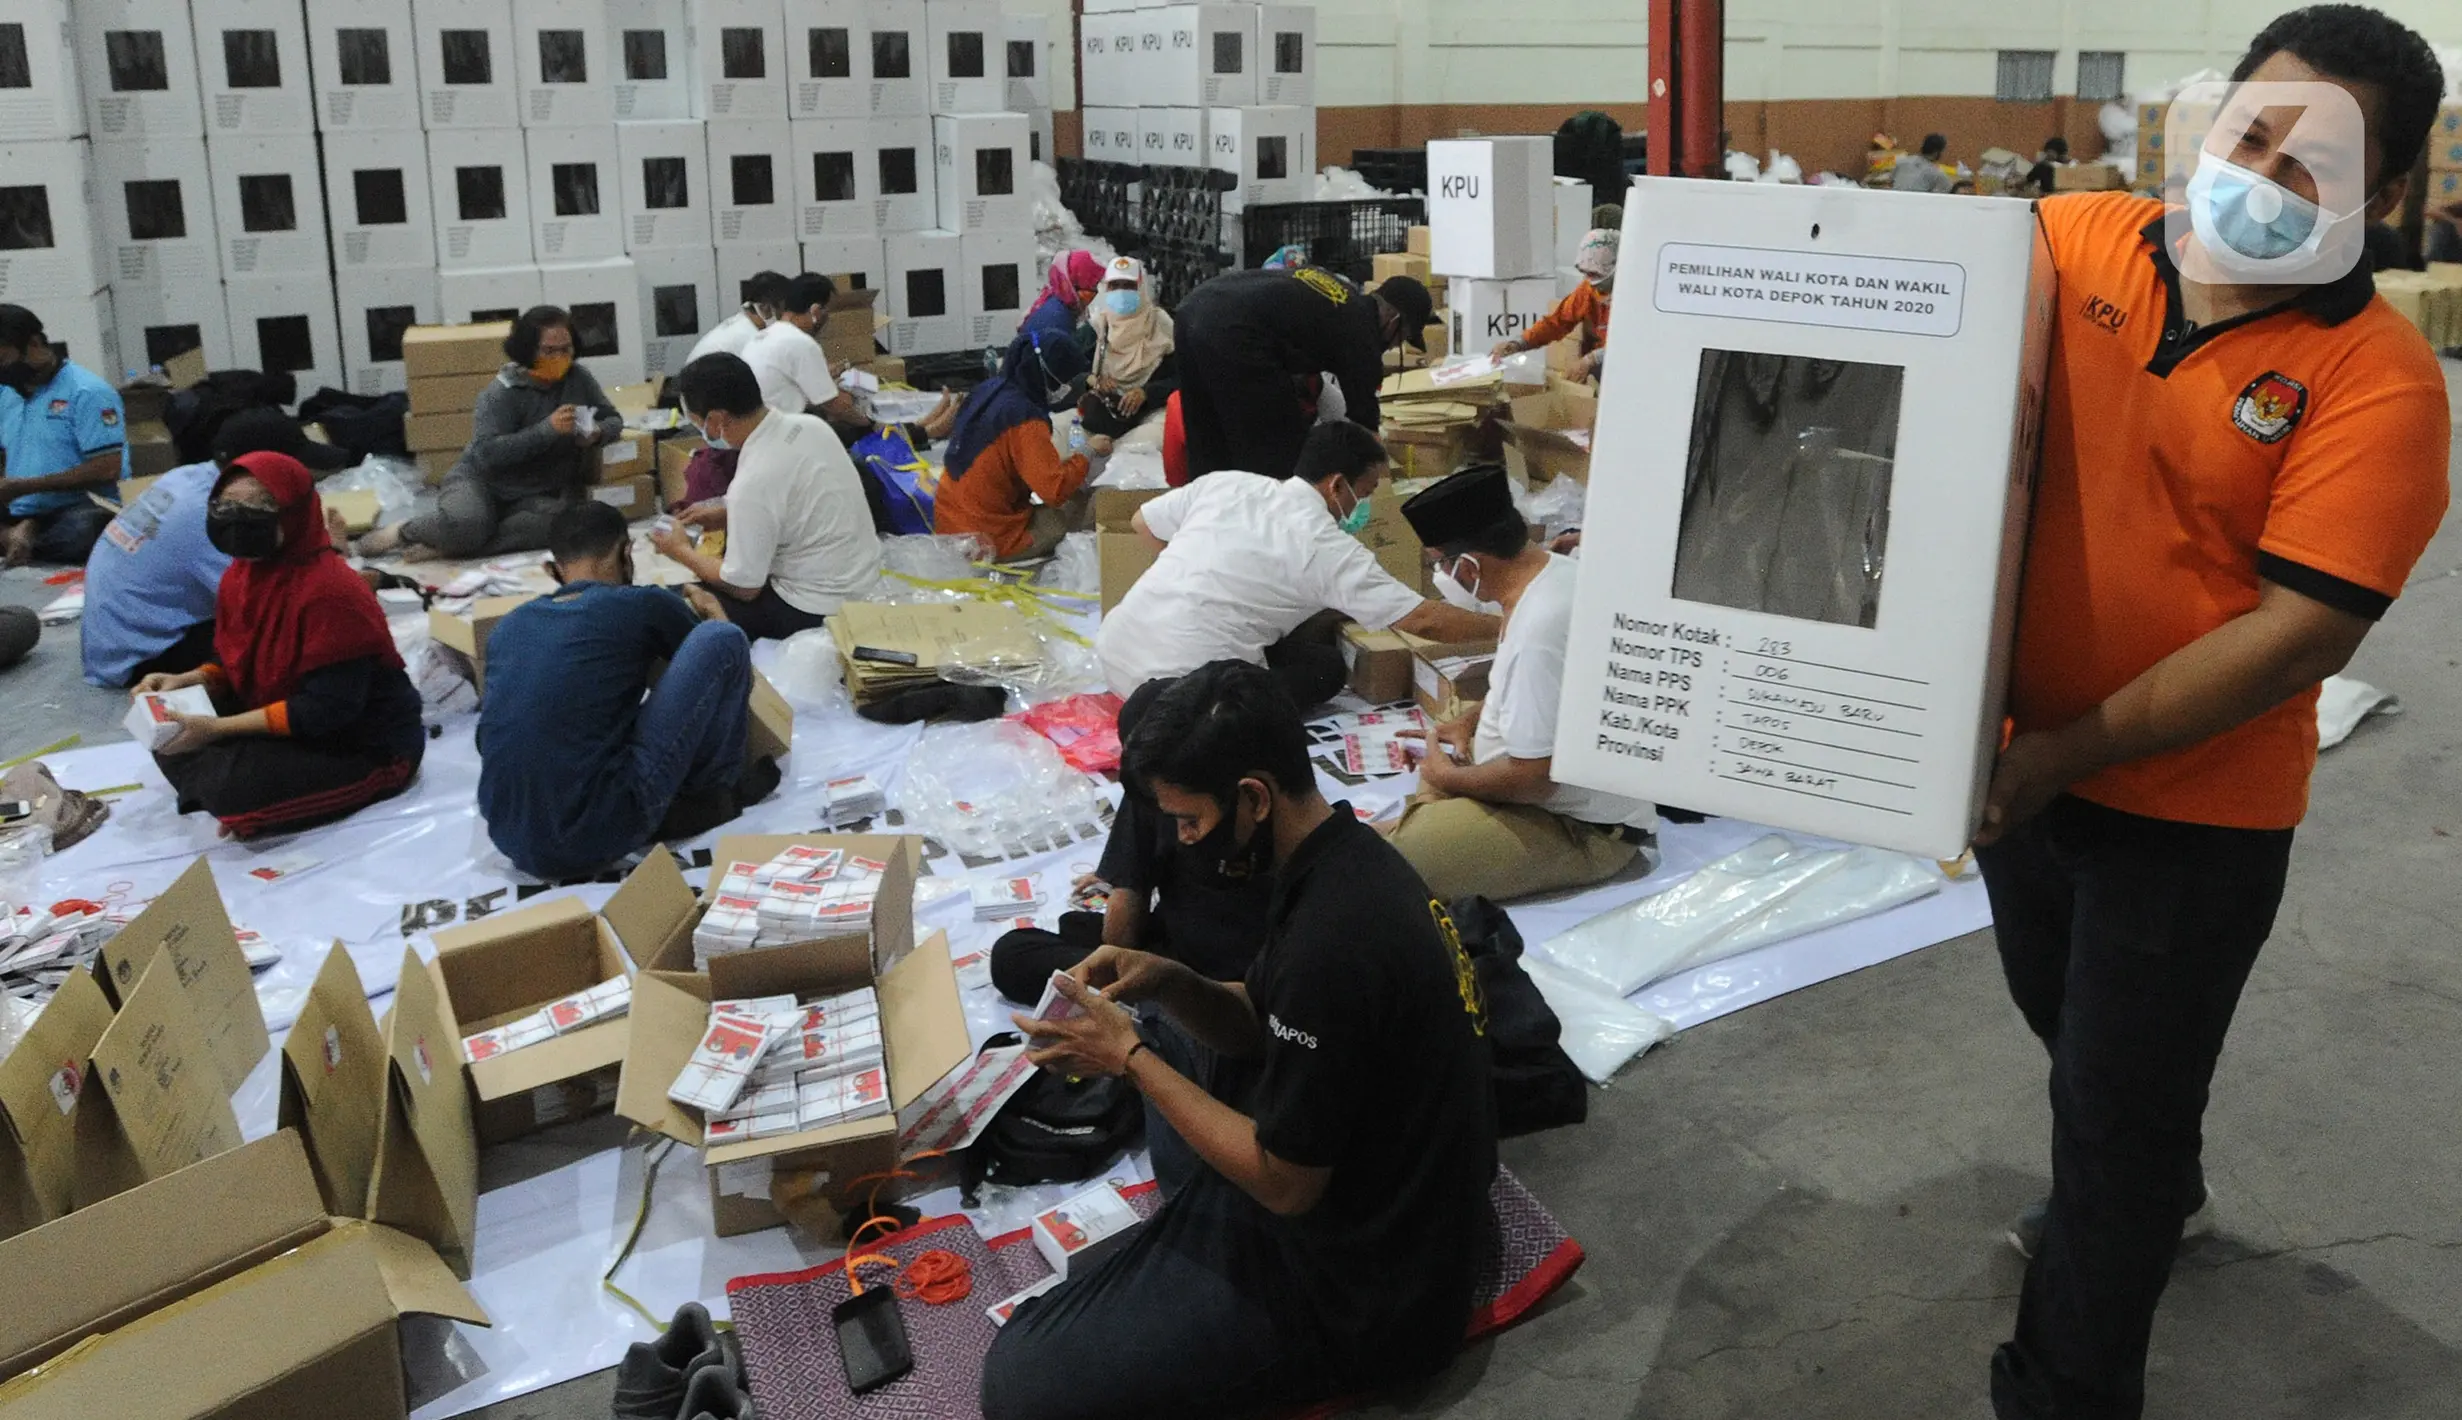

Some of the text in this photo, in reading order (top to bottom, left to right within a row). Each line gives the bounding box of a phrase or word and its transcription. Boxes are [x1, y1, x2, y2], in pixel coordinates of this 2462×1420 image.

[1086, 37, 1104, 53] KPU
[1115, 36, 1134, 52] KPU
[1142, 34, 1161, 50] KPU
[1173, 30, 1192, 48] KPU
[1089, 129, 1106, 147] KPU
[1114, 131, 1132, 148] KPU
[1145, 132, 1164, 150] KPU
[1173, 133, 1194, 151] KPU
[1215, 134, 1235, 153] KPU
[1442, 175, 1479, 199] KPU
[1668, 262, 1951, 295] PEMILIHAN WALI KOTA DAN WAKIL
[1678, 283, 1935, 315] WALI KOTA DEPOK TAHUN 2020
[2087, 295, 2127, 328] KPU
[1613, 612, 1721, 646] Nomor Kotak
[1610, 636, 1702, 668] Nomor TPS
[1757, 636, 1791, 655] 283
[1606, 660, 1692, 692] Nama PPS
[1755, 664, 1789, 680] 006
[1603, 685, 1691, 717] Nama PPK
[1596, 733, 1665, 762] Provinsi
